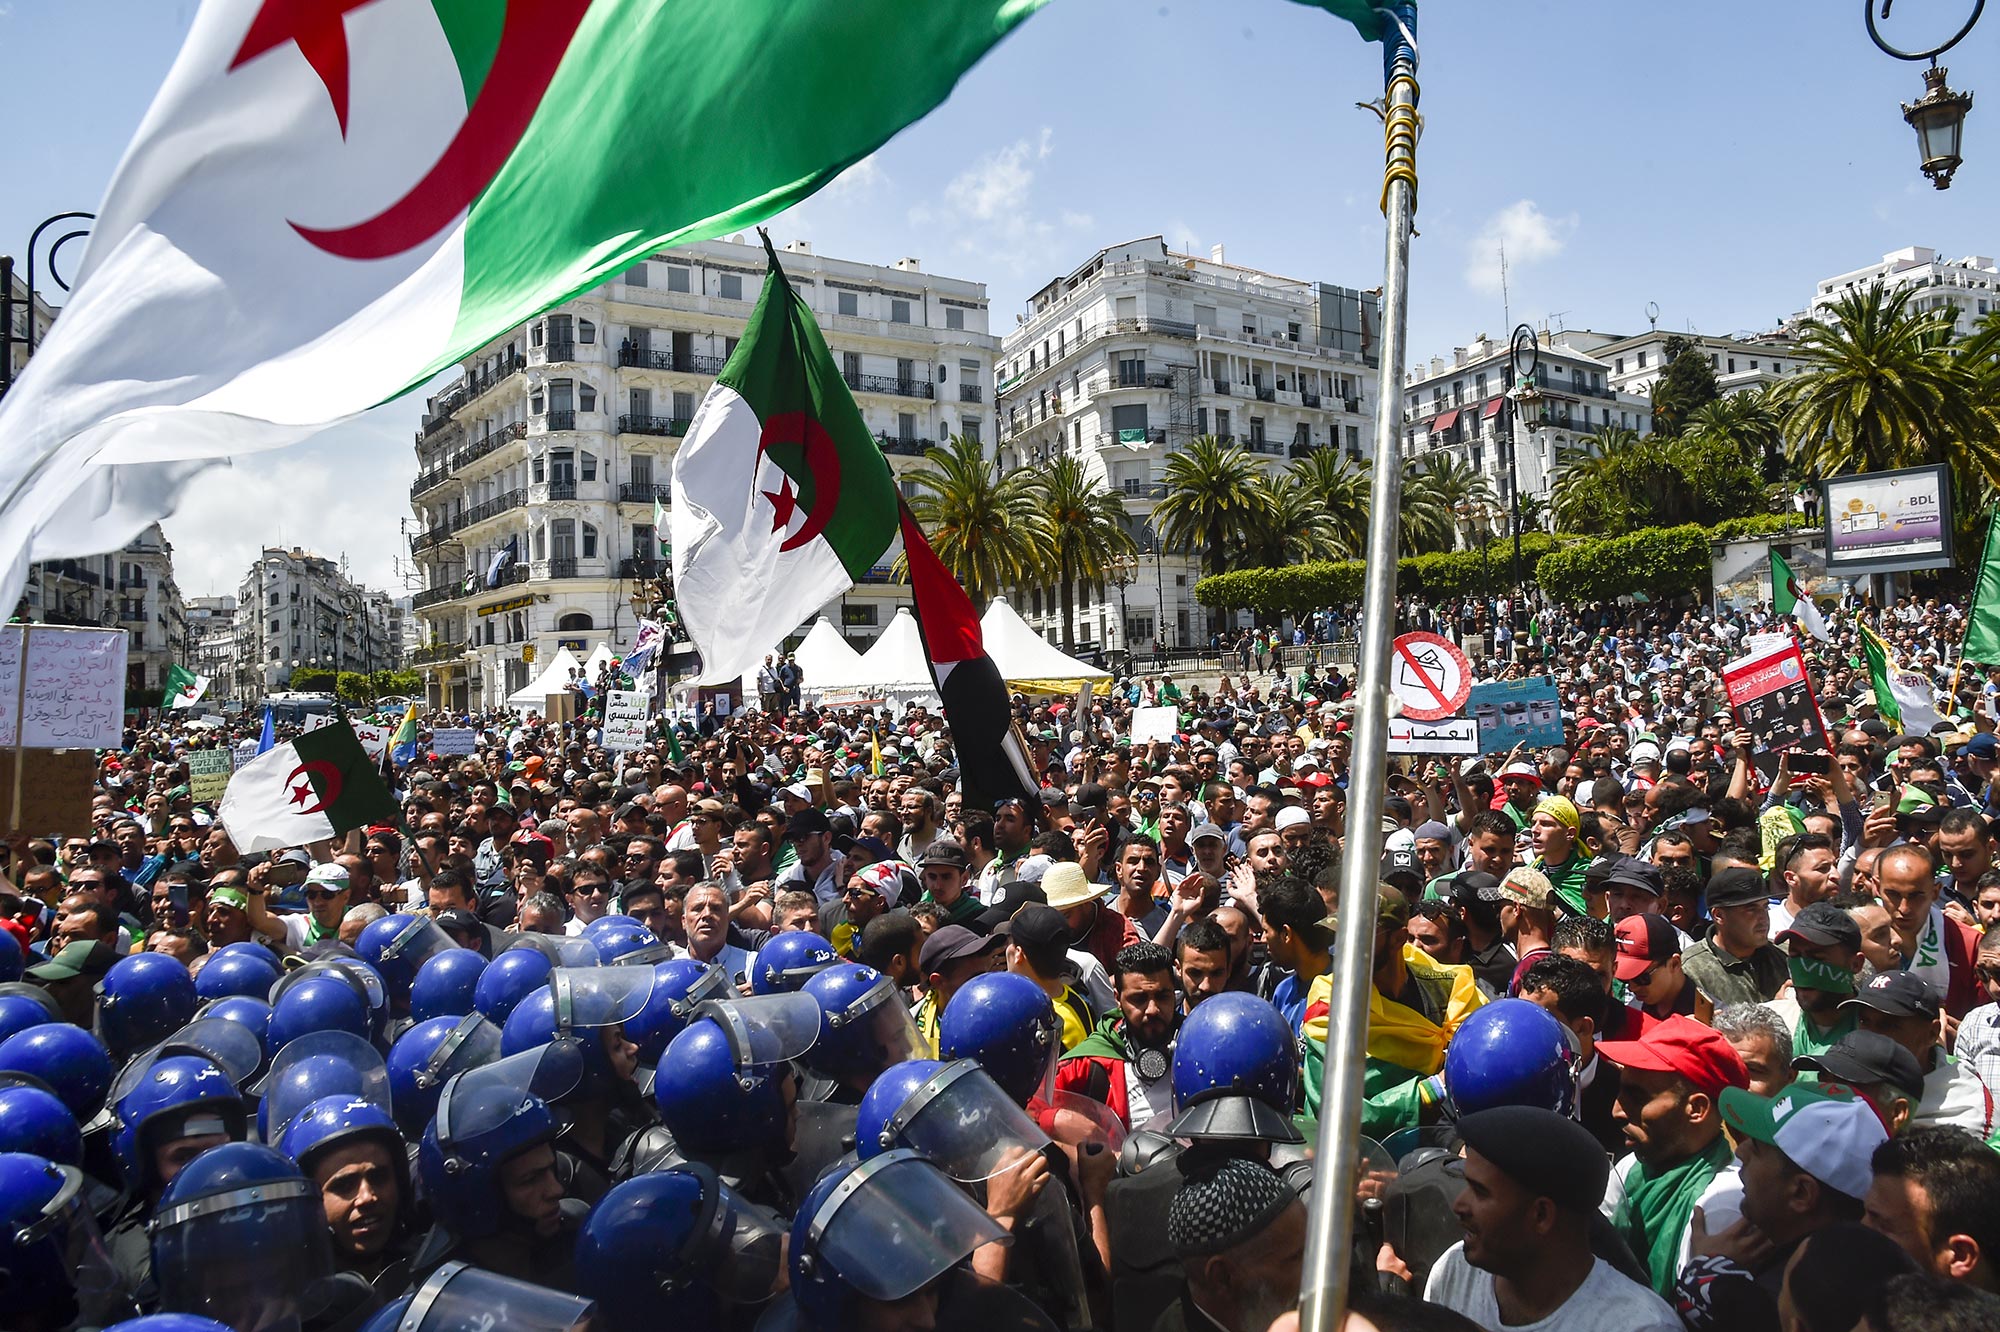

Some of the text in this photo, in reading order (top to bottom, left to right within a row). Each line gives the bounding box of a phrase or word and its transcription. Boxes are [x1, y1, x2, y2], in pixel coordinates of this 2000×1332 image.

[609, 700, 628, 708] مجلس
[608, 708, 646, 722] تأسيسي
[358, 729, 380, 742] نحو
[606, 726, 625, 734] مجلس
[1388, 726, 1474, 744] العصابا
